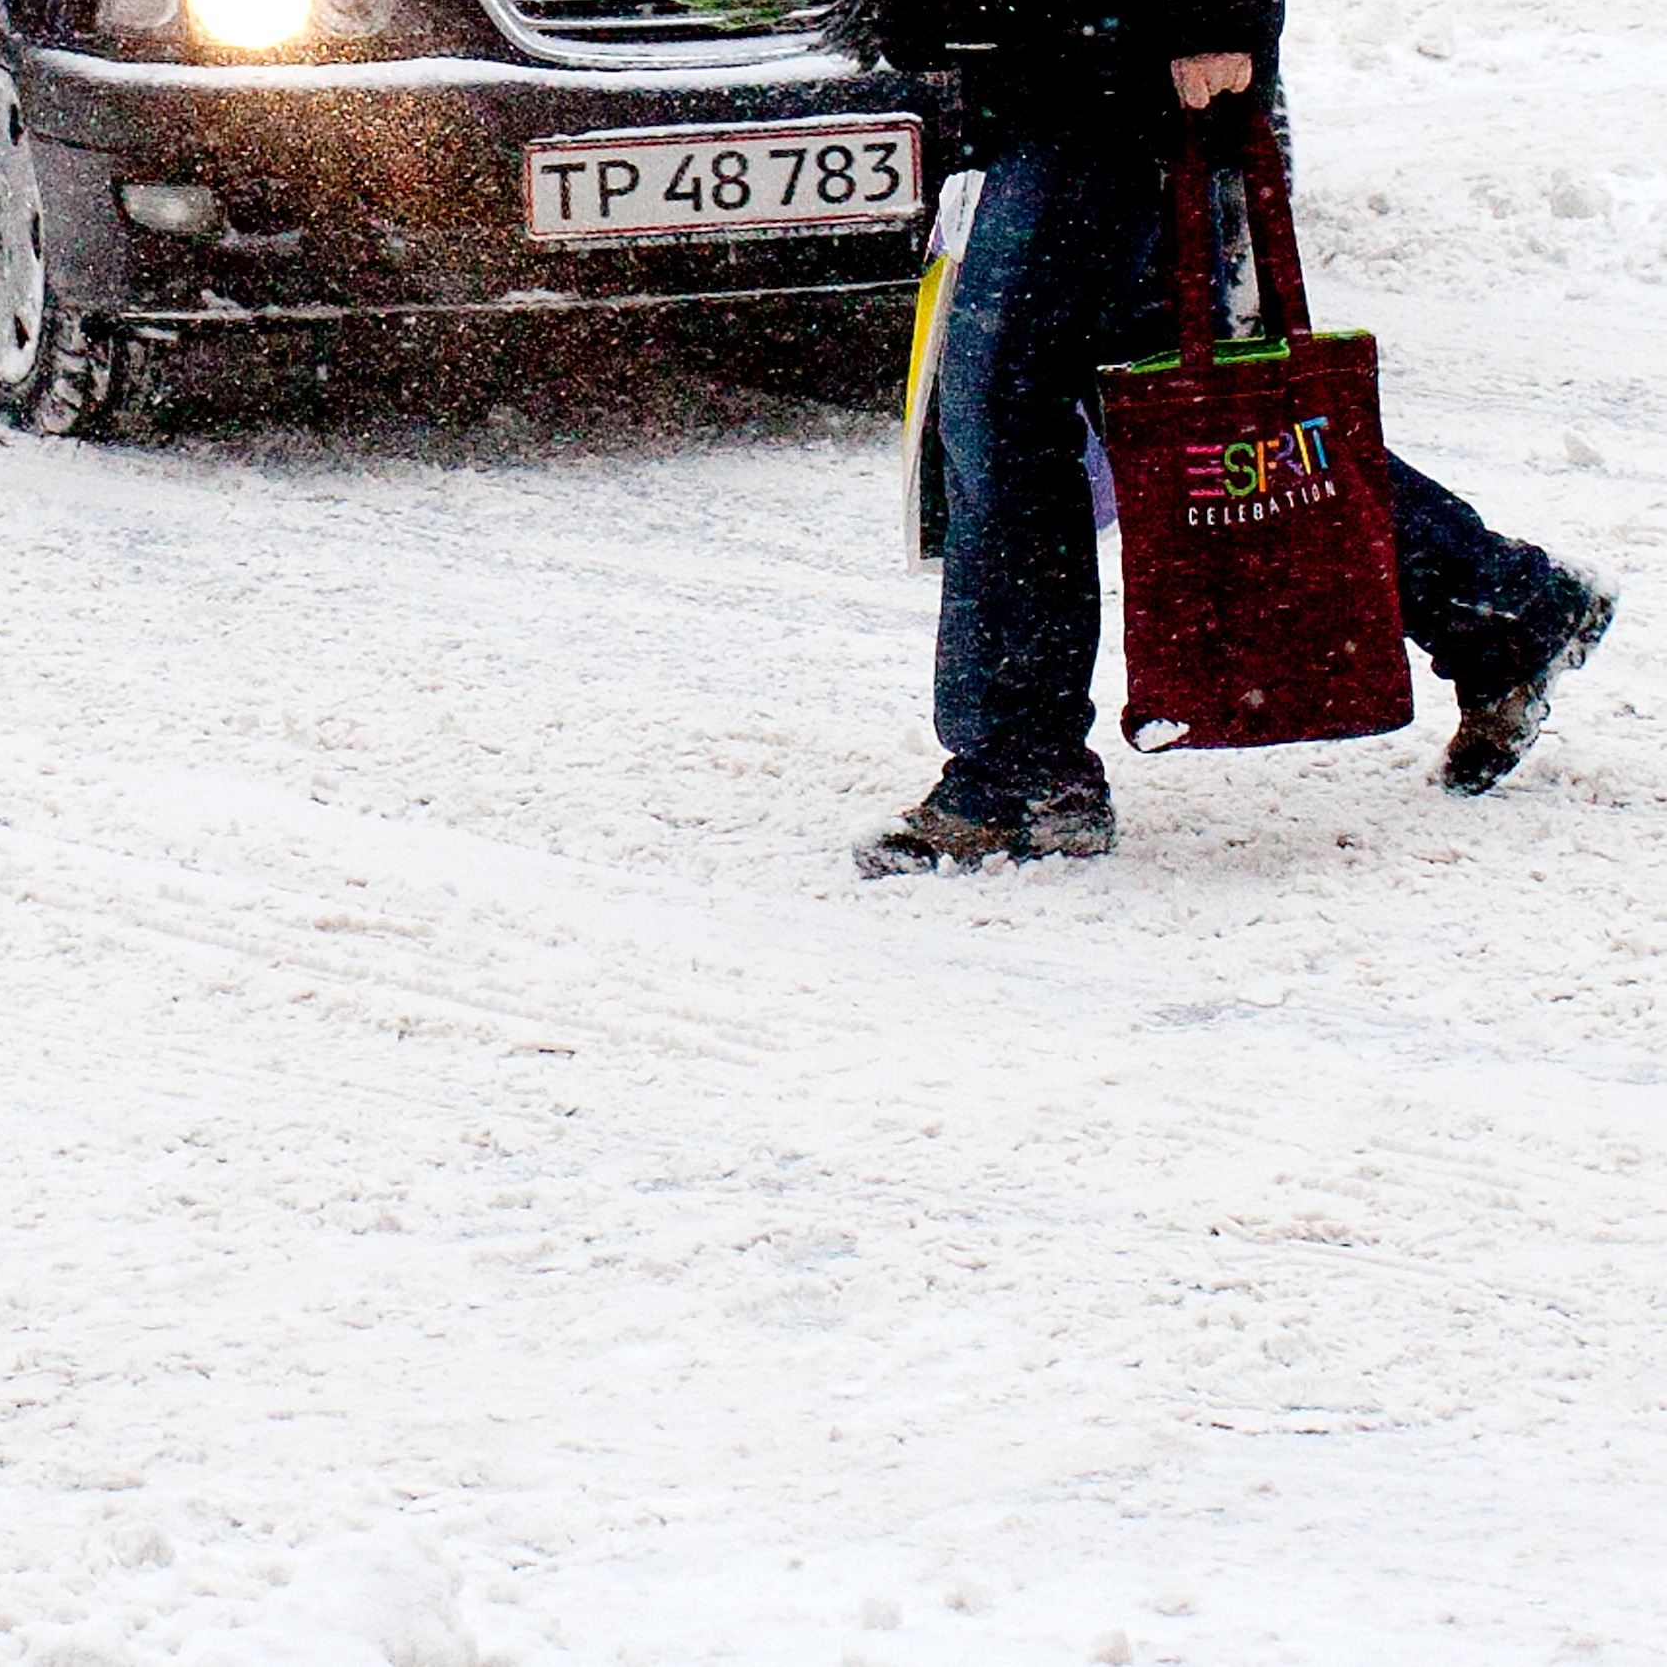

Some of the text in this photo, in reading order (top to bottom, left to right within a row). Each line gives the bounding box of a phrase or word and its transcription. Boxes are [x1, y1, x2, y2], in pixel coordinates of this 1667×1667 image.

[540, 159, 640, 221] TP
[1185, 415, 1330, 497] ESPRIT
[1187, 479, 1337, 527] CELEBATION
